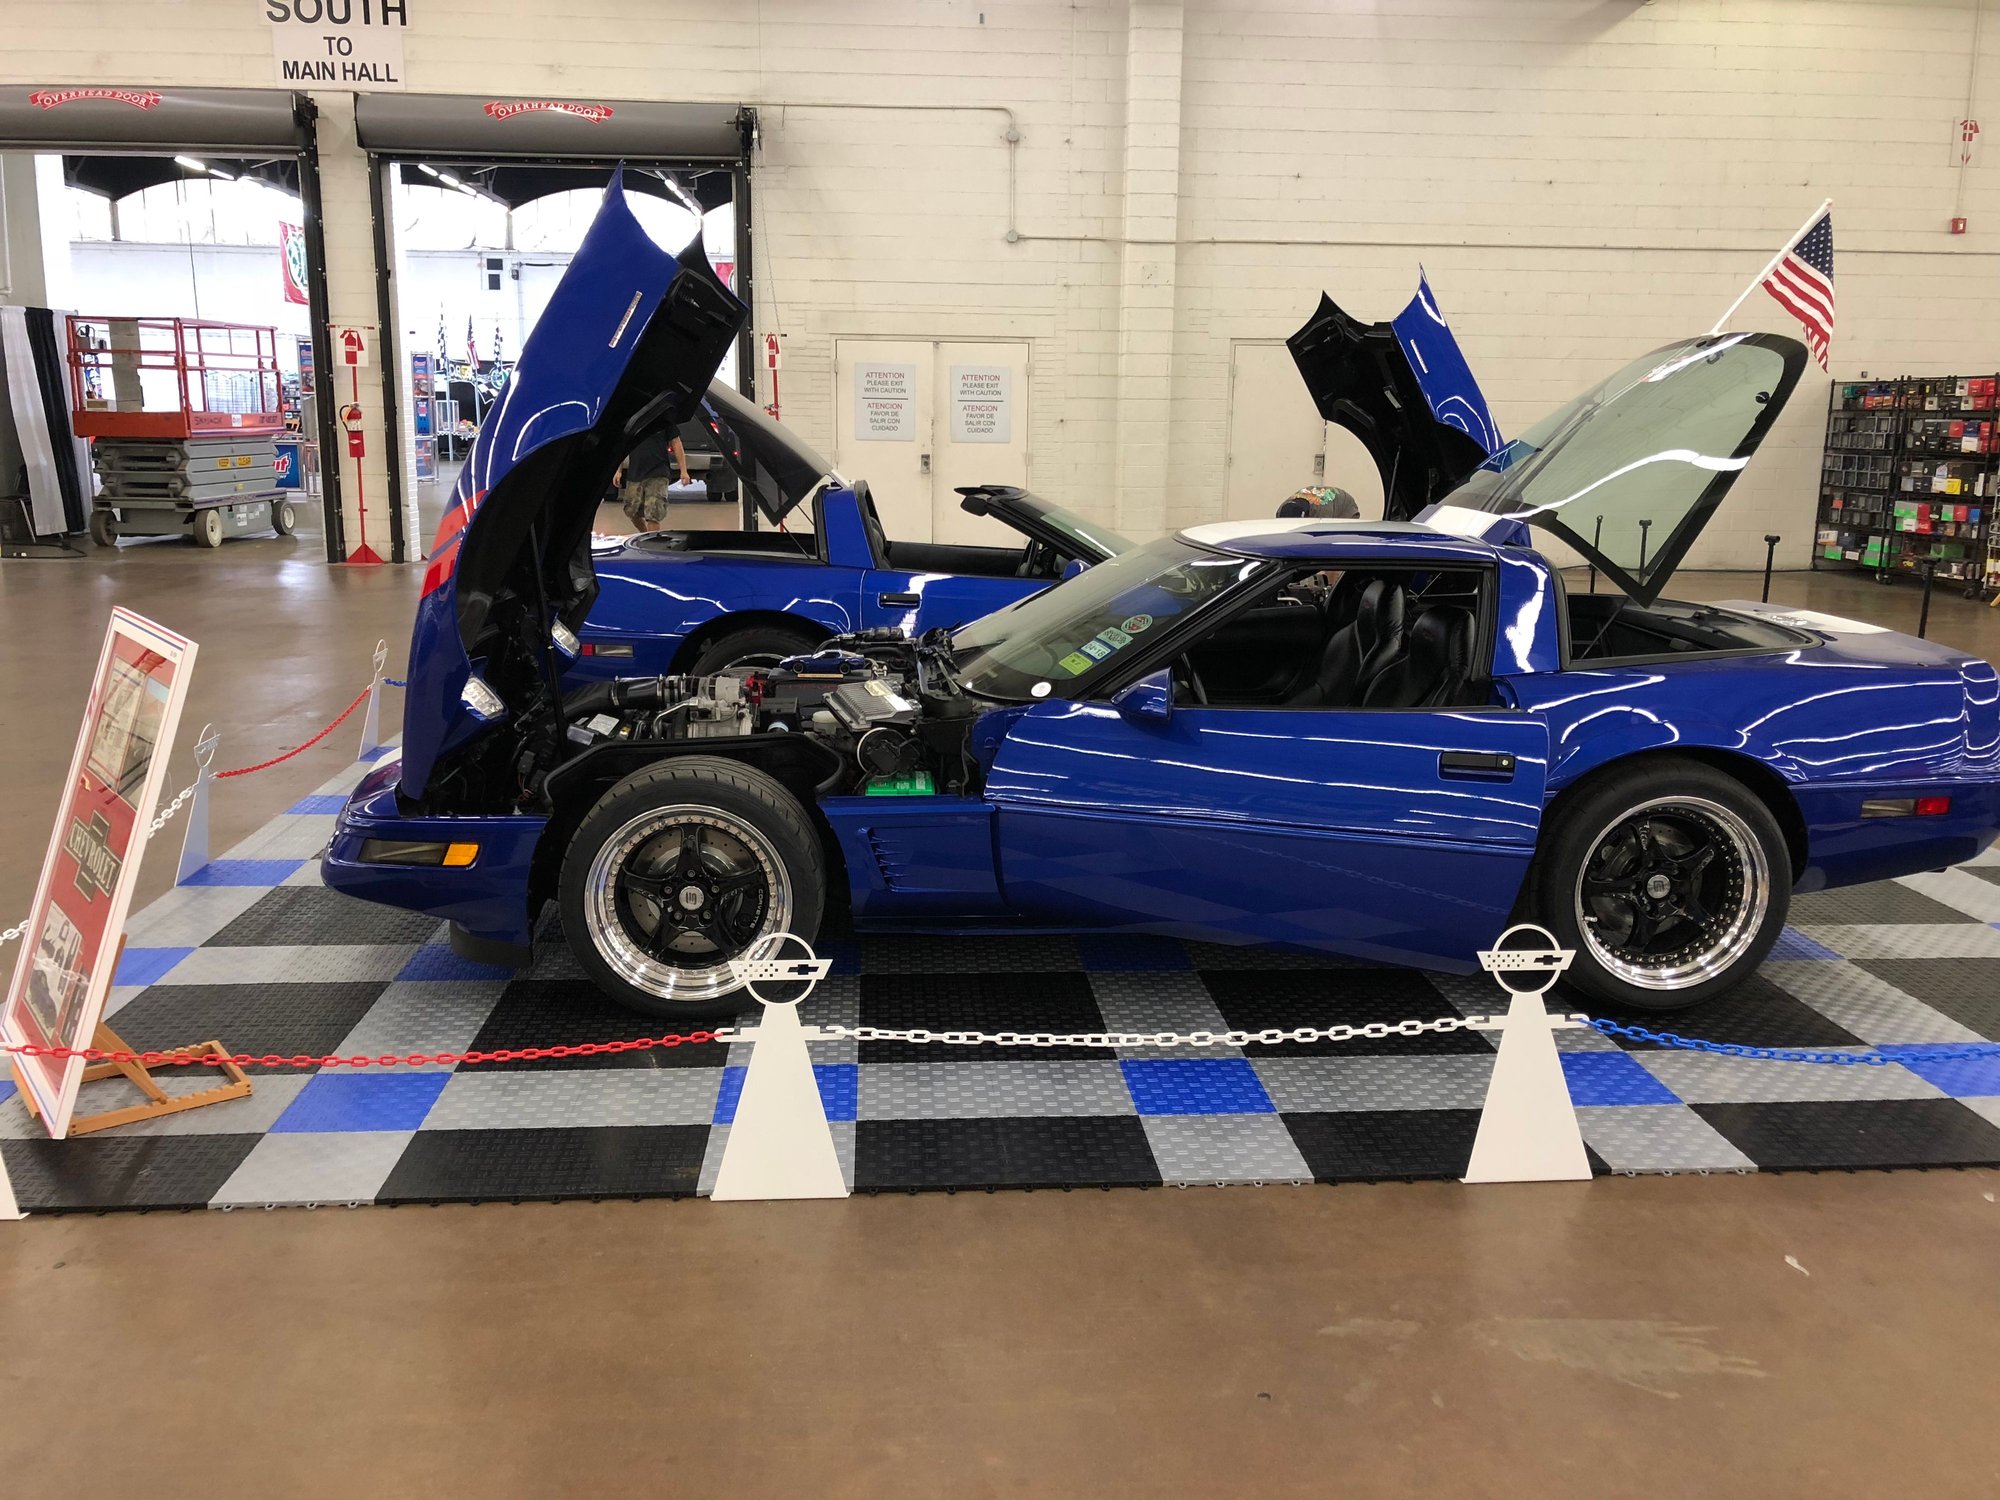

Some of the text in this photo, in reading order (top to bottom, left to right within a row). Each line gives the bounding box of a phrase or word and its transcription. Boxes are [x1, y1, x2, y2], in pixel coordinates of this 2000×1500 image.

[266, 0, 407, 26] SOUTH
[323, 36, 353, 56] TO
[282, 61, 398, 82] MAIN HALL
[43, 90, 147, 107] OVERHEAD DOOR
[498, 102, 598, 120] OVERHEAD DOOR
[867, 402, 903, 410] ATENCION
[69, 823, 117, 890] CHEVROLET
